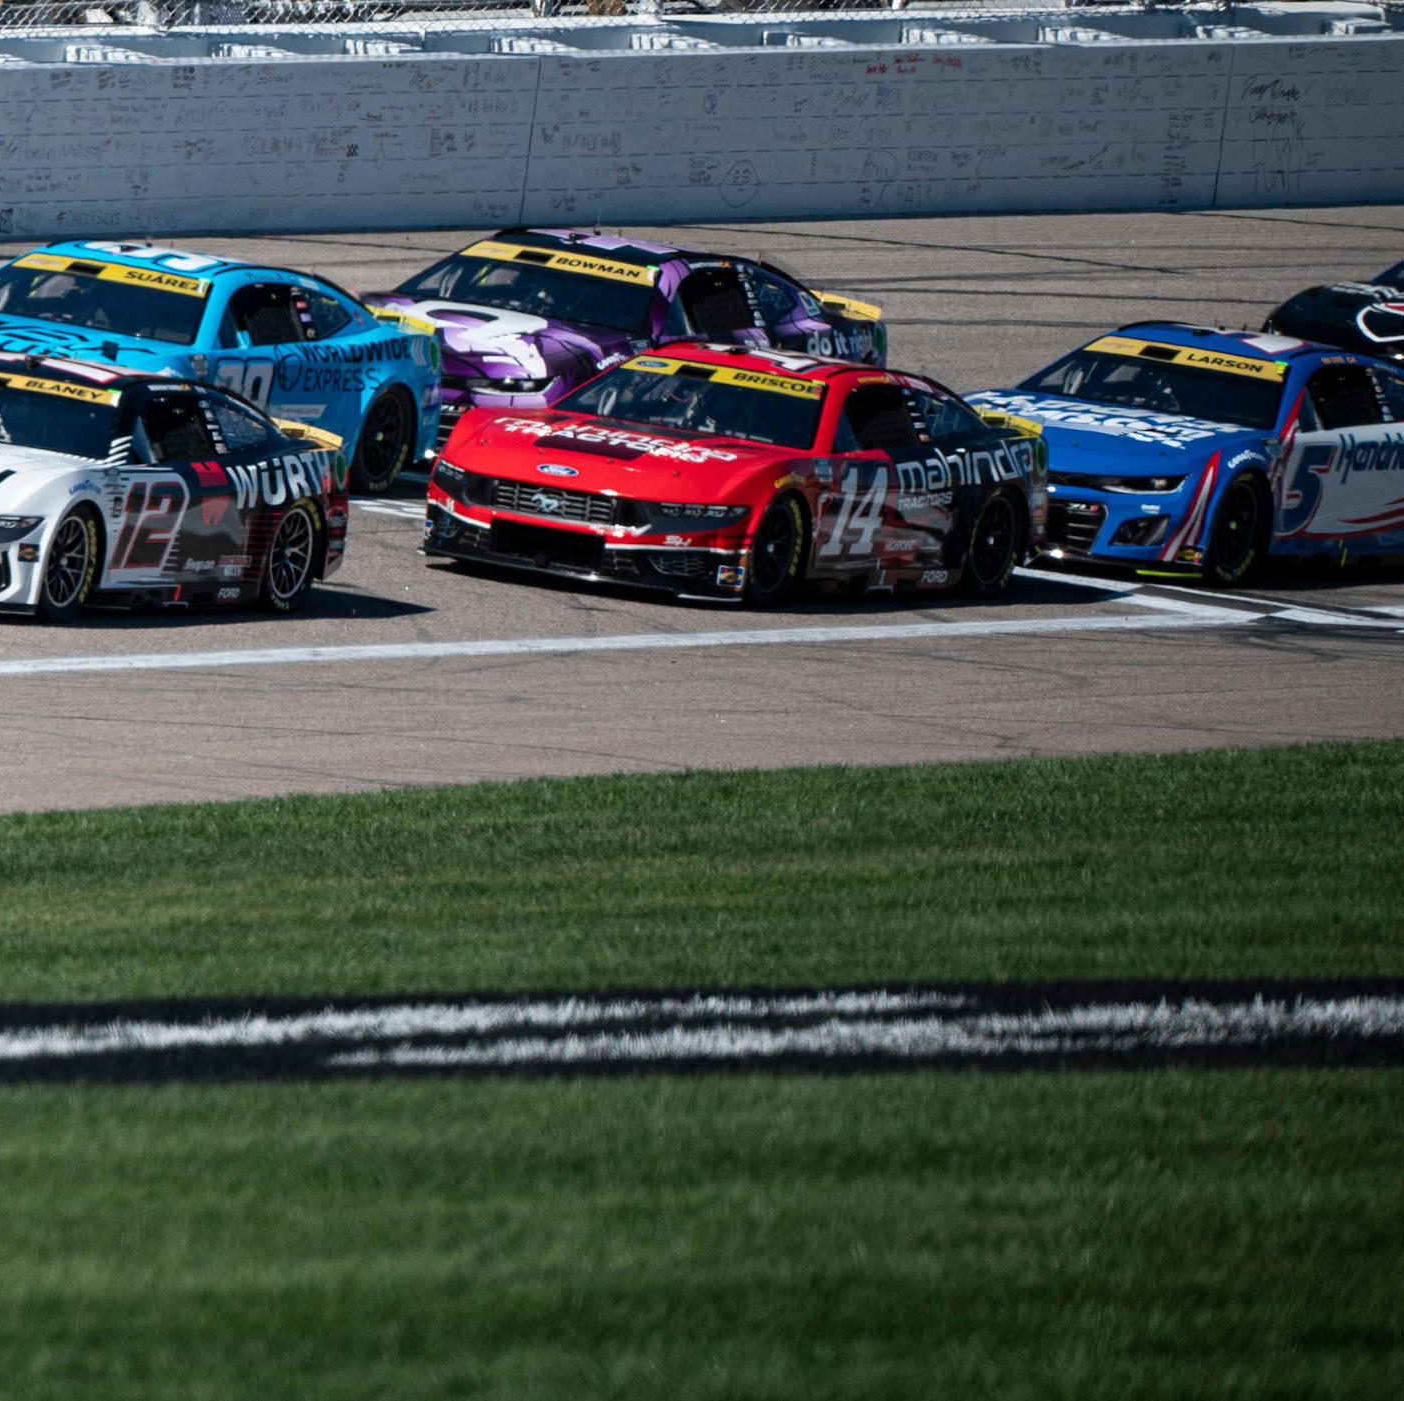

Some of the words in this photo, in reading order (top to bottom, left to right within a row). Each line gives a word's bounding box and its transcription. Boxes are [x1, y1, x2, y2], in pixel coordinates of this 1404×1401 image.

[556, 256, 641, 281] BOWMAN
[299, 338, 412, 364] WORLDWIDE
[807, 330, 833, 356] do
[834, 330, 846, 354] it
[1187, 352, 1263, 374] LARSON
[24, 379, 103, 400] BLANEY
[303, 368, 378, 393] EXPRESS
[733, 372, 817, 396] BRISCOE
[225, 450, 331, 510] WÜRTH
[896, 439, 1035, 496] mahindra
[1273, 442, 1337, 537] 5
[820, 465, 890, 557] 14
[107, 480, 190, 570] 12
[921, 570, 949, 583] FORD
[218, 587, 240, 599] FORD
